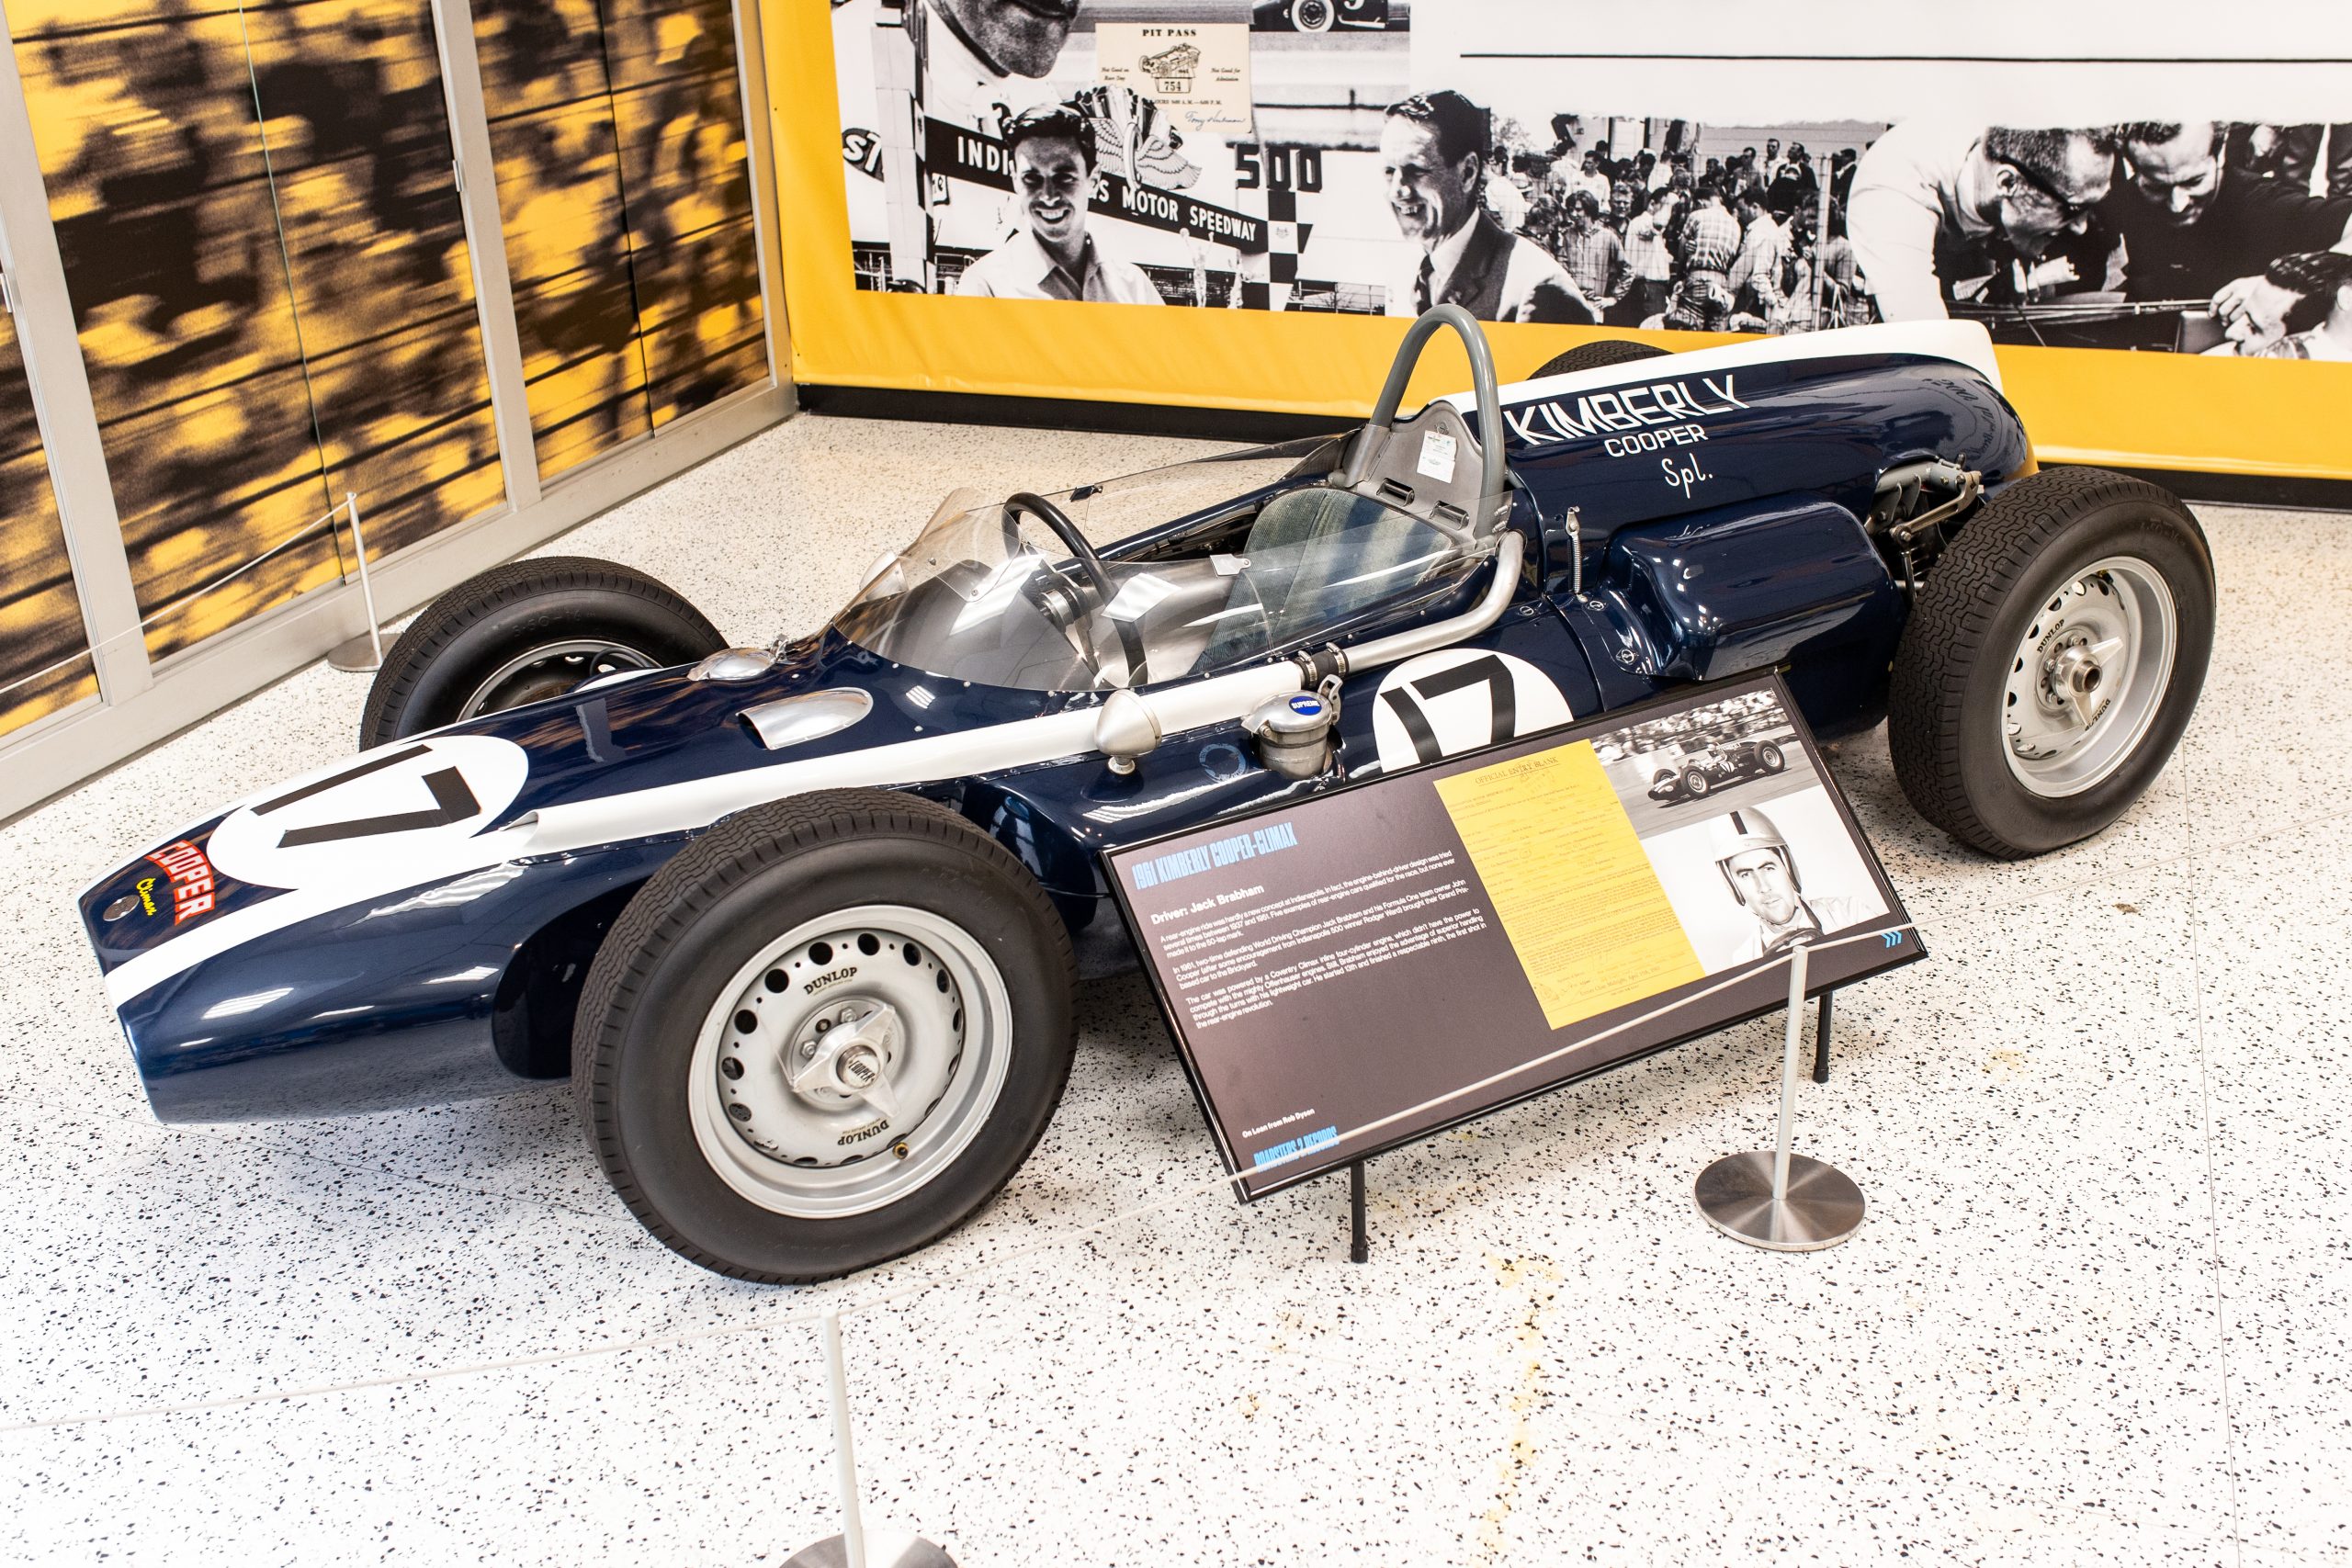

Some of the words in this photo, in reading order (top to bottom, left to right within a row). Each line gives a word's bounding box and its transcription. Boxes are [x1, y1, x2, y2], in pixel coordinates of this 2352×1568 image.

[1164, 81, 1182, 92] 754
[1236, 145, 1322, 192] 500
[1123, 186, 1179, 221] MOTOR
[1189, 205, 1256, 242] SPEEDWAY
[1503, 375, 1749, 446] KIMBERLY
[1604, 423, 1709, 457] COOPER
[1661, 453, 1713, 499] Spl.
[2037, 619, 2064, 653] DUNLOP
[1291, 700, 1320, 709] SUPREME
[1380, 654, 1516, 765] 17
[1476, 772, 1508, 784] OFFICIAL
[1509, 763, 1532, 775] ENTRY
[1533, 757, 1558, 767] BLANK
[250, 744, 481, 848] 17
[1131, 862, 1159, 889] 1961
[1155, 845, 1211, 883] KIMBERLY
[1210, 822, 1297, 867] COOPER-CLIMAX
[136, 878, 157, 916] Climax
[145, 840, 215, 925] COOPER
[1150, 907, 1189, 924] Driver:
[1189, 897, 1216, 912] Jack
[1216, 885, 1264, 905] Brabham
[1176, 970, 1200, 981] Cooper
[1201, 964, 1217, 975] (after
[1218, 959, 1236, 968] some
[1237, 943, 1282, 963] encouragement
[1282, 940, 1296, 948] from
[1296, 930, 1330, 943] Indianapolis
[1330, 924, 1343, 933] 500
[1344, 919, 1363, 929] winner
[1363, 912, 1385, 923] Rodger
[1385, 906, 1403, 916] Ward)
[1402, 899, 1425, 910] brought
[1425, 896, 1438, 904] their
[1438, 890, 1455, 899] Grand
[1196, 953, 1224, 966] two-time
[1223, 944, 1254, 957] defending
[1253, 938, 1272, 949] World
[1272, 932, 1293, 942] Driving
[1292, 923, 1322, 936] Champion
[1322, 918, 1336, 927] Jack
[1336, 911, 1363, 923] Brabham
[1363, 907, 1374, 915] and
[1383, 897, 1407, 908] Formula
[1419, 889, 1434, 897] team
[1434, 884, 1452, 893] owner
[1452, 879, 1465, 887] John
[804, 967, 857, 994] DUNLOP
[1186, 997, 1200, 1005] The
[1227, 978, 1254, 993] powered
[1270, 965, 1298, 978] Coventry
[1298, 959, 1318, 969] Climax
[1336, 942, 1372, 957] four-cylinder
[1373, 936, 1394, 946] engine,
[1395, 929, 1411, 939] which
[1429, 919, 1442, 928] have
[1454, 910, 1472, 921] power
[1190, 999, 1217, 1012] compete
[1218, 994, 1232, 1003] with
[1244, 985, 1264, 995] mighty
[1264, 973, 1301, 988] Offenhauser
[1302, 965, 1326, 976] engines.
[1339, 953, 1365, 964] Brabham
[1366, 944, 1388, 956] enjoyed
[1399, 932, 1429, 945] advantage
[1436, 923, 1459, 934] superior
[1459, 916, 1484, 927] handling
[1193, 1007, 1218, 1021] through
[1229, 999, 1246, 1009] turns
[1246, 994, 1260, 1003] with
[1270, 981, 1301, 996] lightweight
[1324, 967, 1344, 978] started
[1345, 963, 1357, 972] 13th
[1358, 959, 1369, 967] and
[1369, 952, 1392, 964] finished
[1397, 941, 1430, 955] respectable
[1430, 935, 1446, 944] ninth,
[1456, 928, 1467, 936] first
[1468, 924, 1480, 932] shot
[848, 1060, 876, 1082] COOPER
[837, 1120, 889, 1145] DUNLOP
[1252, 1126, 1268, 1134] Loan
[1268, 1120, 1283, 1129] from
[1283, 1114, 1295, 1124] Rob
[1295, 1109, 1315, 1119] Dyson
